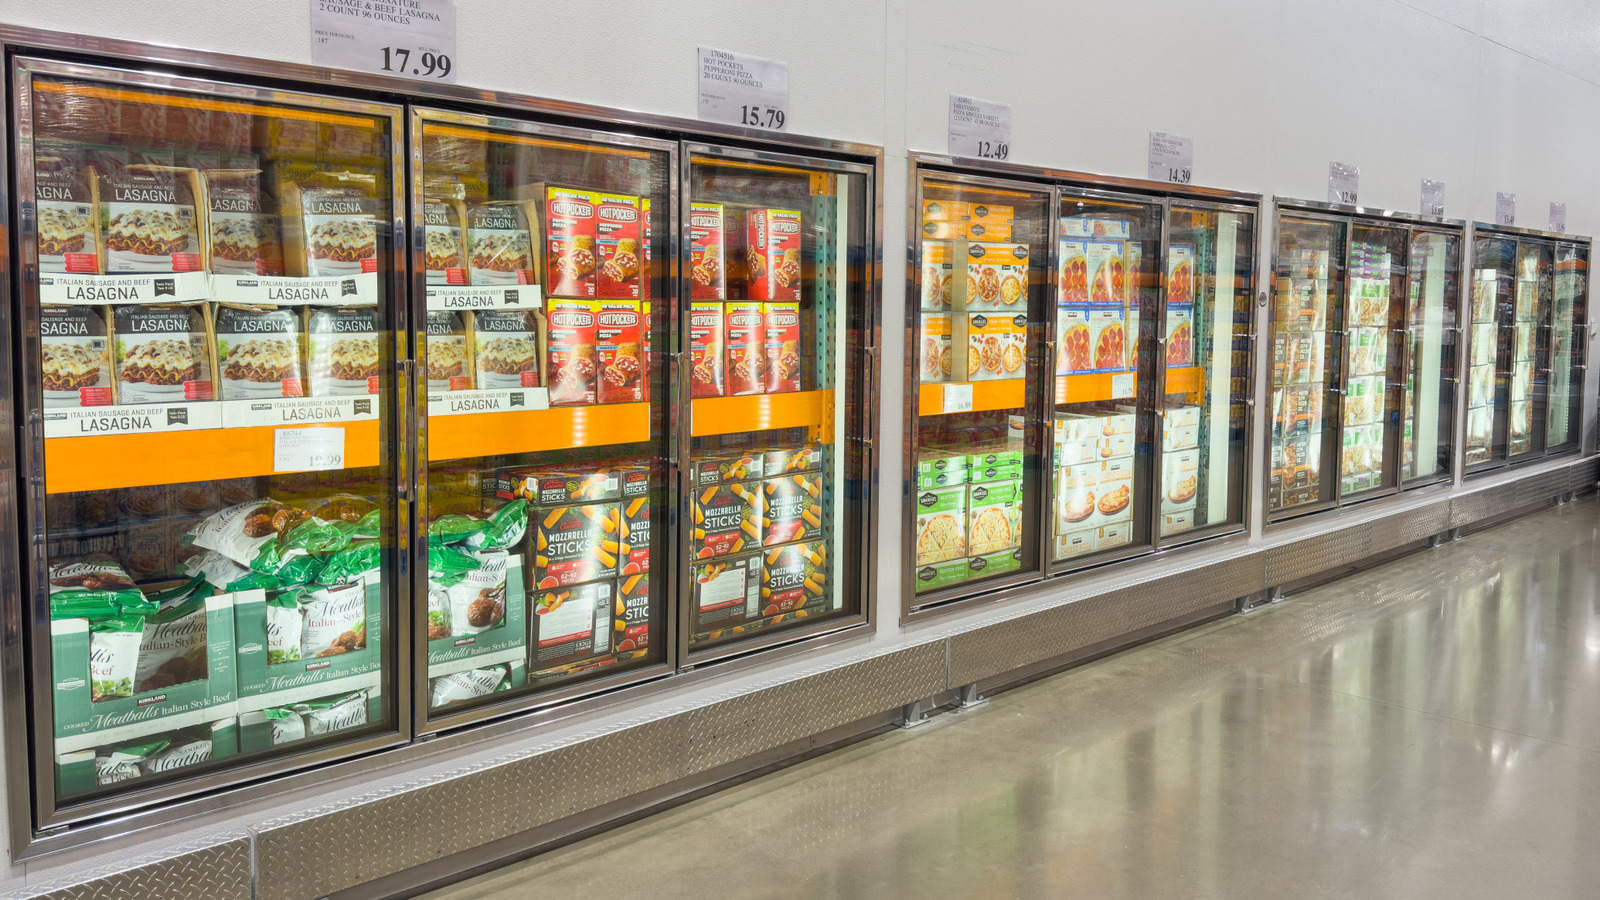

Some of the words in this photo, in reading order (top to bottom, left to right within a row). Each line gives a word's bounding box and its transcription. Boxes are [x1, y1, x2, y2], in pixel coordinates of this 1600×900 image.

[320, 3, 325, 11] 2
[327, 5, 360, 16] COUNT
[362, 11, 371, 19] 96
[374, 10, 411, 25] OUNCES
[365, 2, 372, 10] &
[375, 3, 396, 14] BEEF
[399, 8, 441, 22] LASAGNA
[380, 46, 451, 78] 17.99
[711, 50, 734, 61] 1704516
[704, 57, 716, 65] HOT
[718, 59, 744, 70] POCKETS
[704, 65, 735, 76] PEPPERONI
[737, 71, 753, 79] PIZZA
[711, 73, 732, 82] COUNT
[740, 78, 763, 88] OUNCES
[740, 105, 785, 129] 15.79
[977, 141, 1008, 160] 12.49
[1168, 168, 1190, 183] 14.39
[115, 189, 177, 202] LASAGNA
[1341, 191, 1357, 204] 12.99
[311, 202, 362, 213] LASAGNA
[475, 218, 517, 228] LASAGNA
[67, 286, 139, 300] LASAGNA
[269, 288, 329, 300] LASAGNA
[445, 296, 494, 307] LASAGNA
[131, 319, 191, 332] LASAGNA
[234, 320, 287, 332] LASAGNA
[325, 321, 374, 332] LASAGNA
[484, 321, 525, 331] LASAGNA
[274, 401, 296, 409] ITALIAN
[451, 400, 499, 411] LASAGNA
[282, 407, 341, 421] LASAGNA
[80, 417, 151, 432] LASAGNA
[700, 474, 719, 483] STICKS
[626, 486, 647, 494] STICKS
[542, 493, 565, 501] STICKS
[705, 505, 741, 516] MOZZARELLA
[770, 504, 803, 518] STICKS
[704, 515, 741, 528] STICKS
[549, 529, 592, 542] MOZZARELLA
[548, 540, 592, 555] STICKS
[770, 573, 804, 588] STICKS
[455, 637, 475, 645] KIRKLAND
[471, 645, 491, 654] Italian
[492, 642, 507, 651] Style
[508, 638, 522, 647] Beef
[306, 661, 330, 669] KIRKLAND
[243, 683, 266, 691] COOKED
[260, 670, 325, 692] Meatballs
[326, 669, 349, 679] Italian
[351, 666, 368, 675] Style
[138, 695, 166, 704] KIRKLAND
[64, 722, 90, 730] COOKED
[82, 705, 160, 732] Meatballs
[161, 703, 189, 715] Italian
[191, 699, 211, 709] Style
[213, 692, 231, 704] Beef
